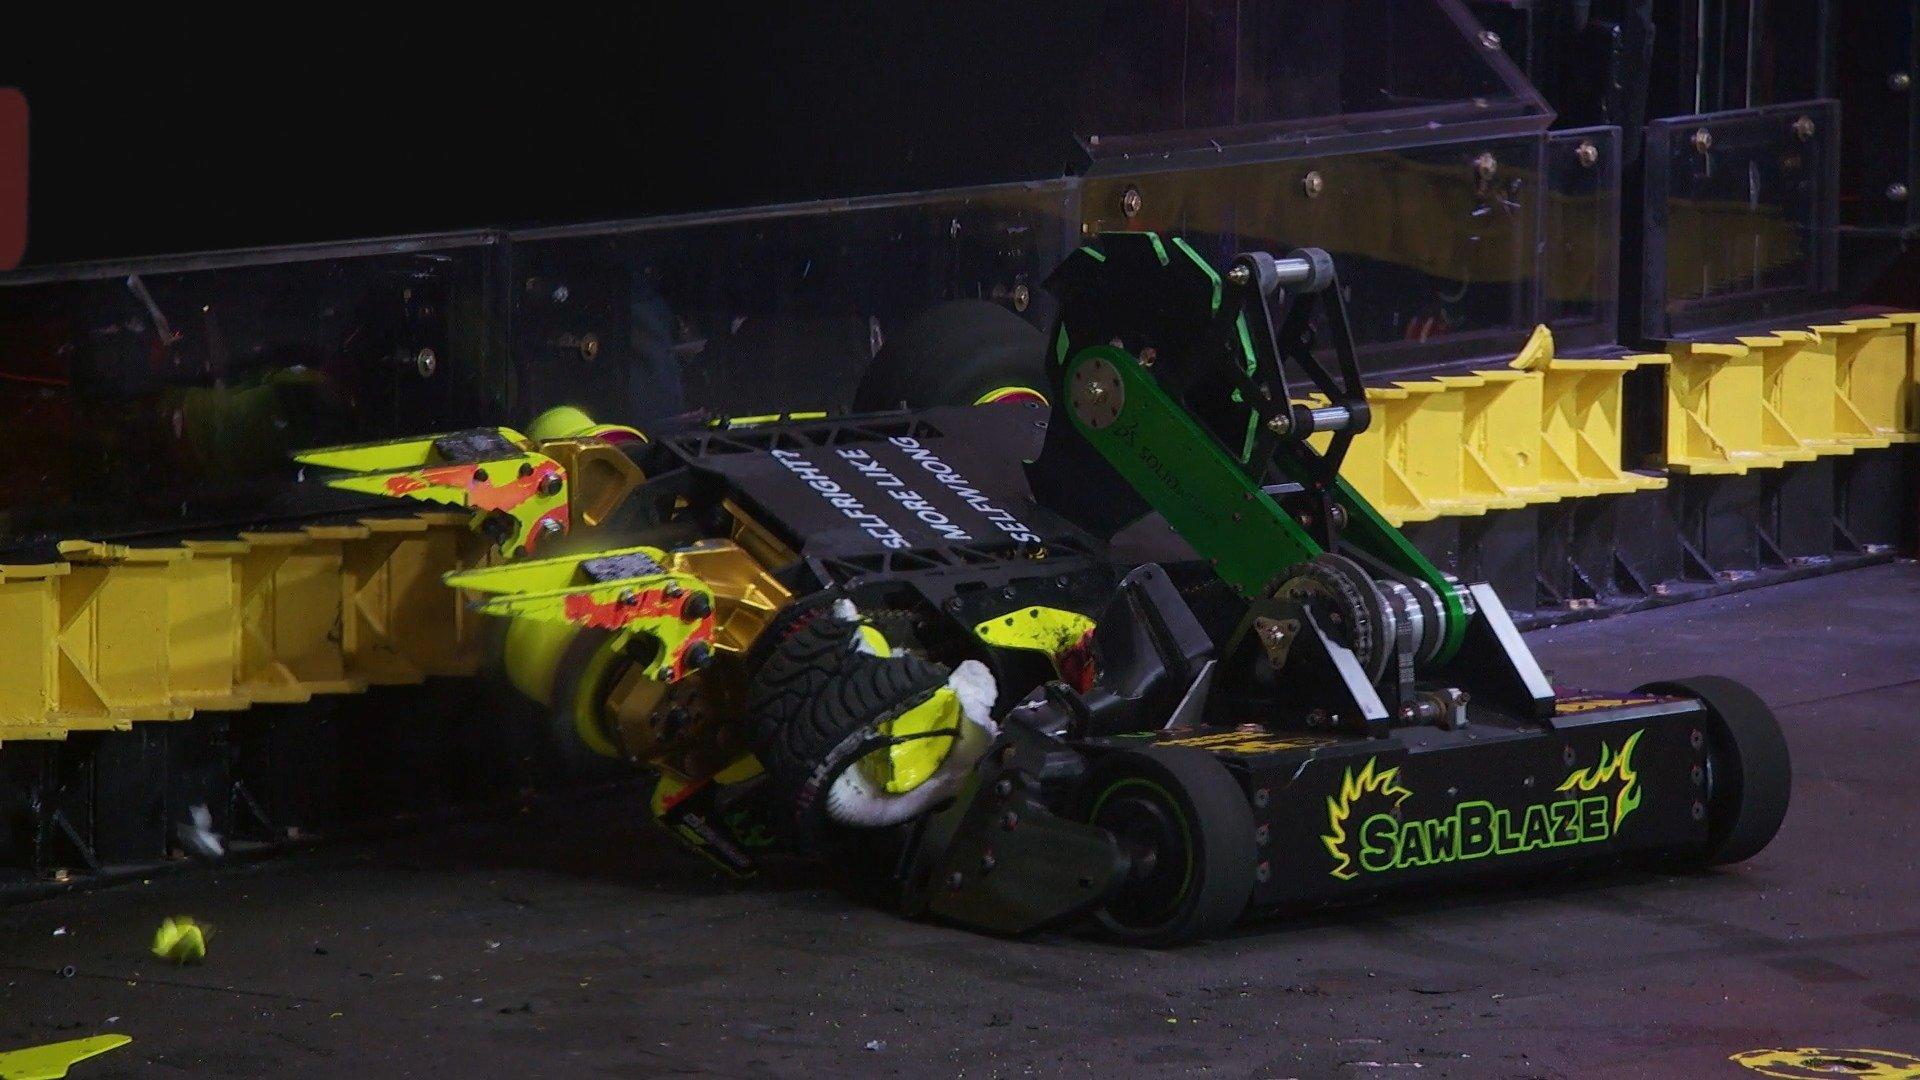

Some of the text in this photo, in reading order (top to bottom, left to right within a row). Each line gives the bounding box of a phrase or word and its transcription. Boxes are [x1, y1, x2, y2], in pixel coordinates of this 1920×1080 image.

[836, 448, 973, 541] MORE LIKE
[887, 435, 1043, 544] SELFWRONG
